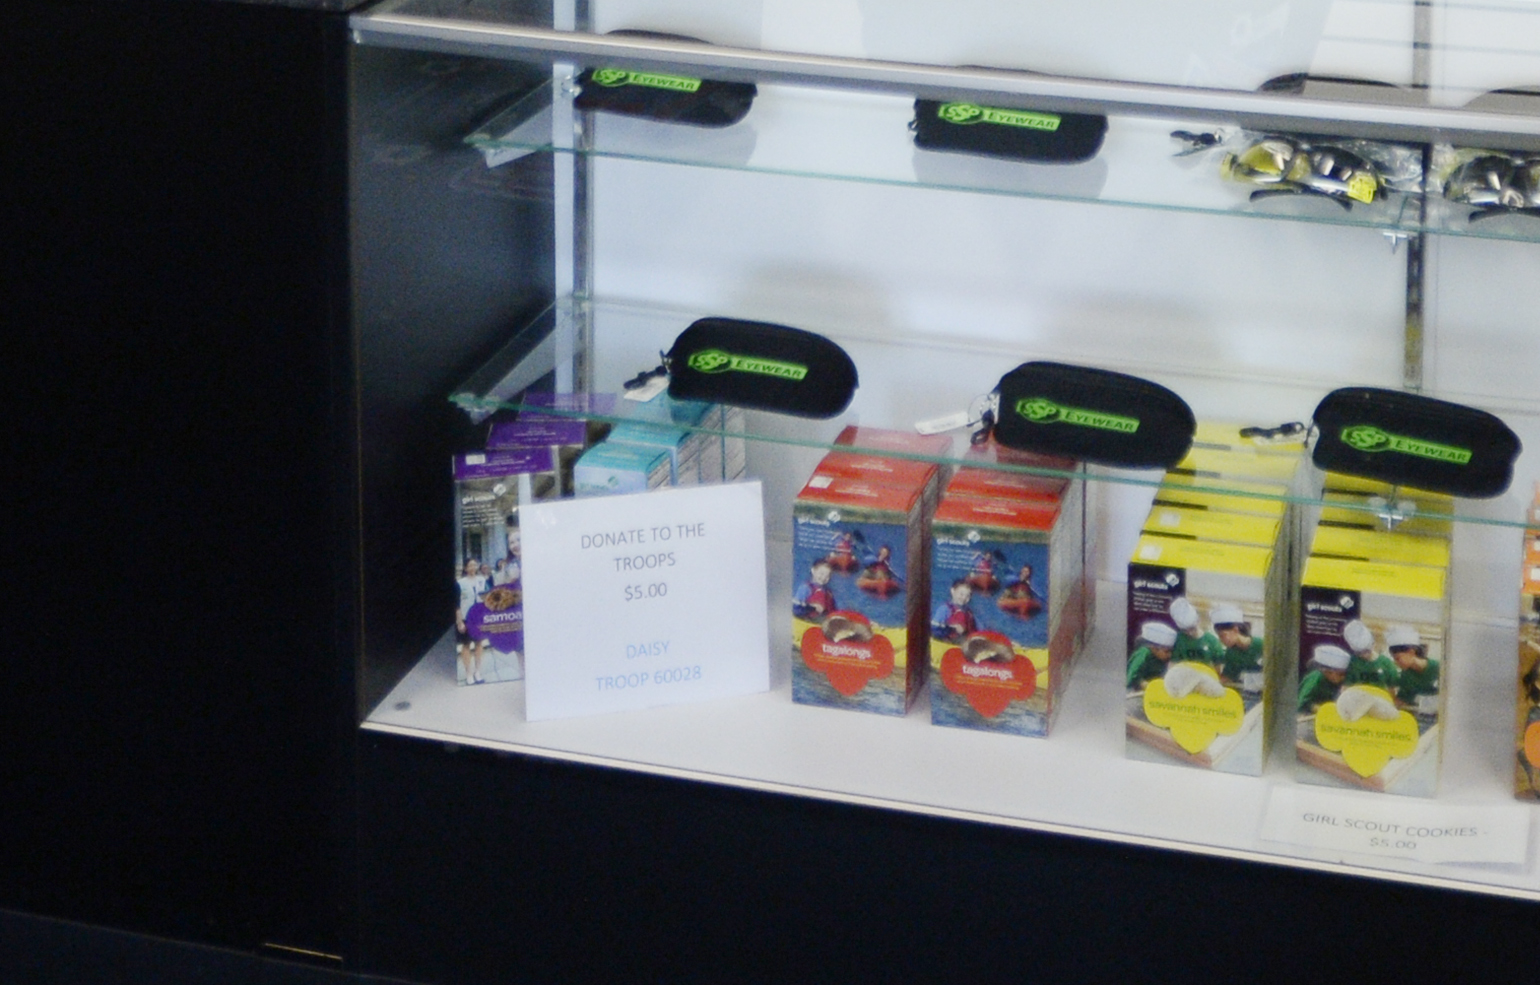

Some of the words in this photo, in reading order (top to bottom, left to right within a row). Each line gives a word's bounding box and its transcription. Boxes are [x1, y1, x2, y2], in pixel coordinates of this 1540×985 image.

[581, 529, 645, 549] DONATE
[651, 526, 672, 542] TO
[676, 523, 706, 539] THE
[613, 552, 677, 572] TROOPS
[624, 582, 668, 601] $5.00
[483, 611, 523, 624] samoa
[626, 641, 670, 659] DAISY
[822, 643, 872, 660] tagalongs
[595, 672, 649, 691] TROOP
[654, 665, 703, 685] 60028
[962, 664, 1013, 680] tagalongs
[1148, 699, 1201, 715] savannah
[1202, 704, 1237, 718] smiles
[1320, 723, 1374, 738] savannah
[1375, 729, 1412, 742] smiles
[1302, 812, 1339, 827] GIRL
[1344, 817, 1401, 834] SCOUT
[1405, 826, 1478, 839] COOKIES
[1369, 837, 1417, 851] $5.00
